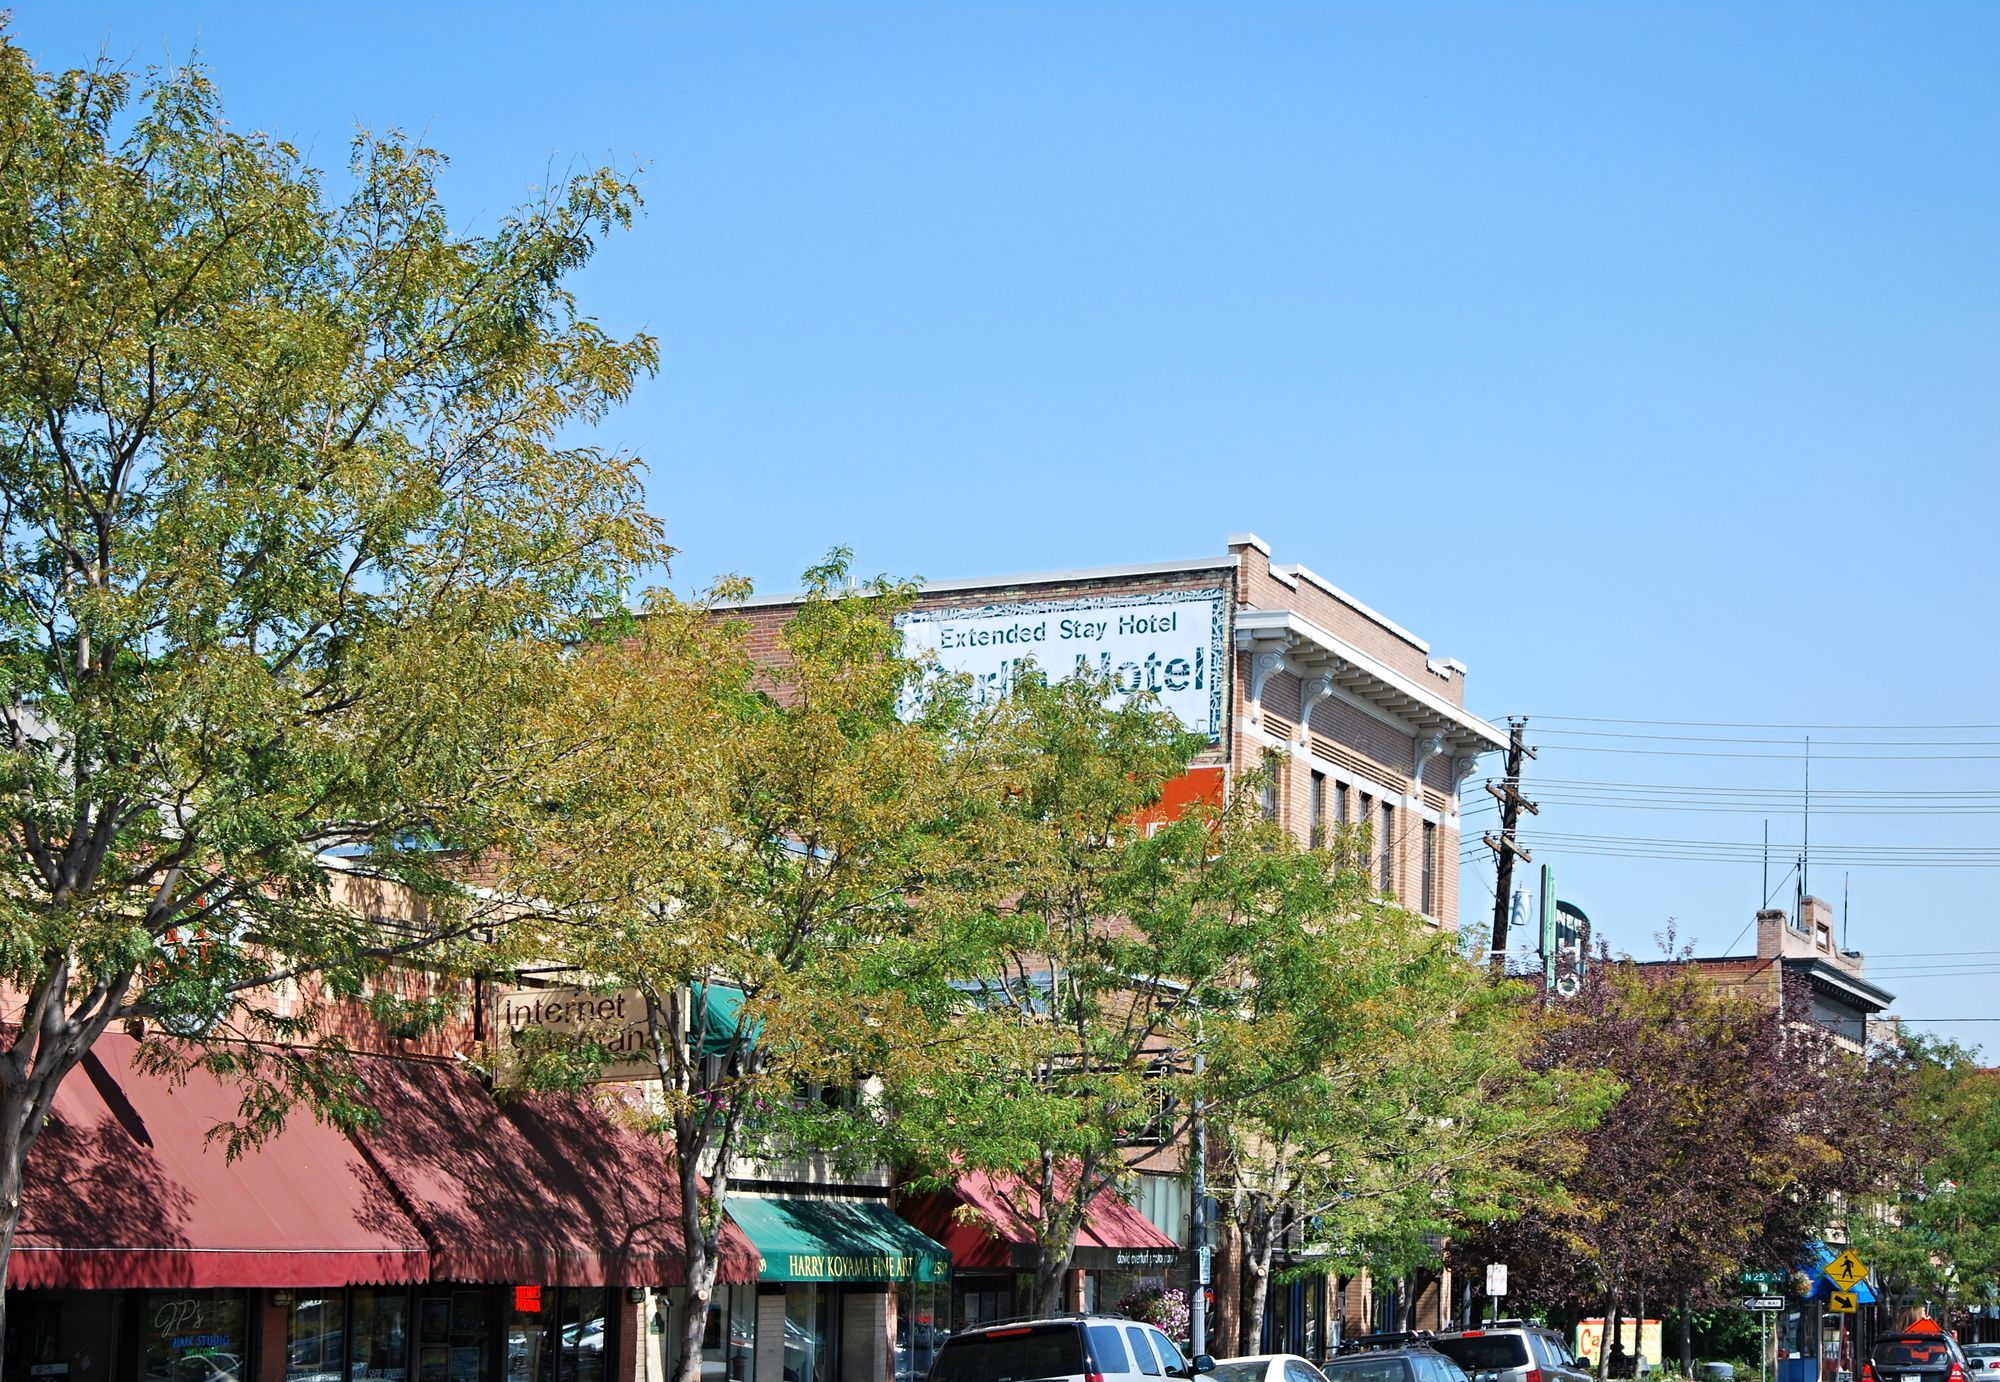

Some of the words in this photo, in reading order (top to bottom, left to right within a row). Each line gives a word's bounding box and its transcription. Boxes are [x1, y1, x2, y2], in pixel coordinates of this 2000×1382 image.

[941, 622, 1046, 648] Extended
[1059, 617, 1107, 641] Stay
[1118, 611, 1177, 635] Hotel
[505, 993, 625, 1025] internet
[789, 1255, 824, 1276] HARRY
[827, 1256, 870, 1277] KOYAMA
[872, 1257, 894, 1277] FINE
[896, 1257, 913, 1277] ART
